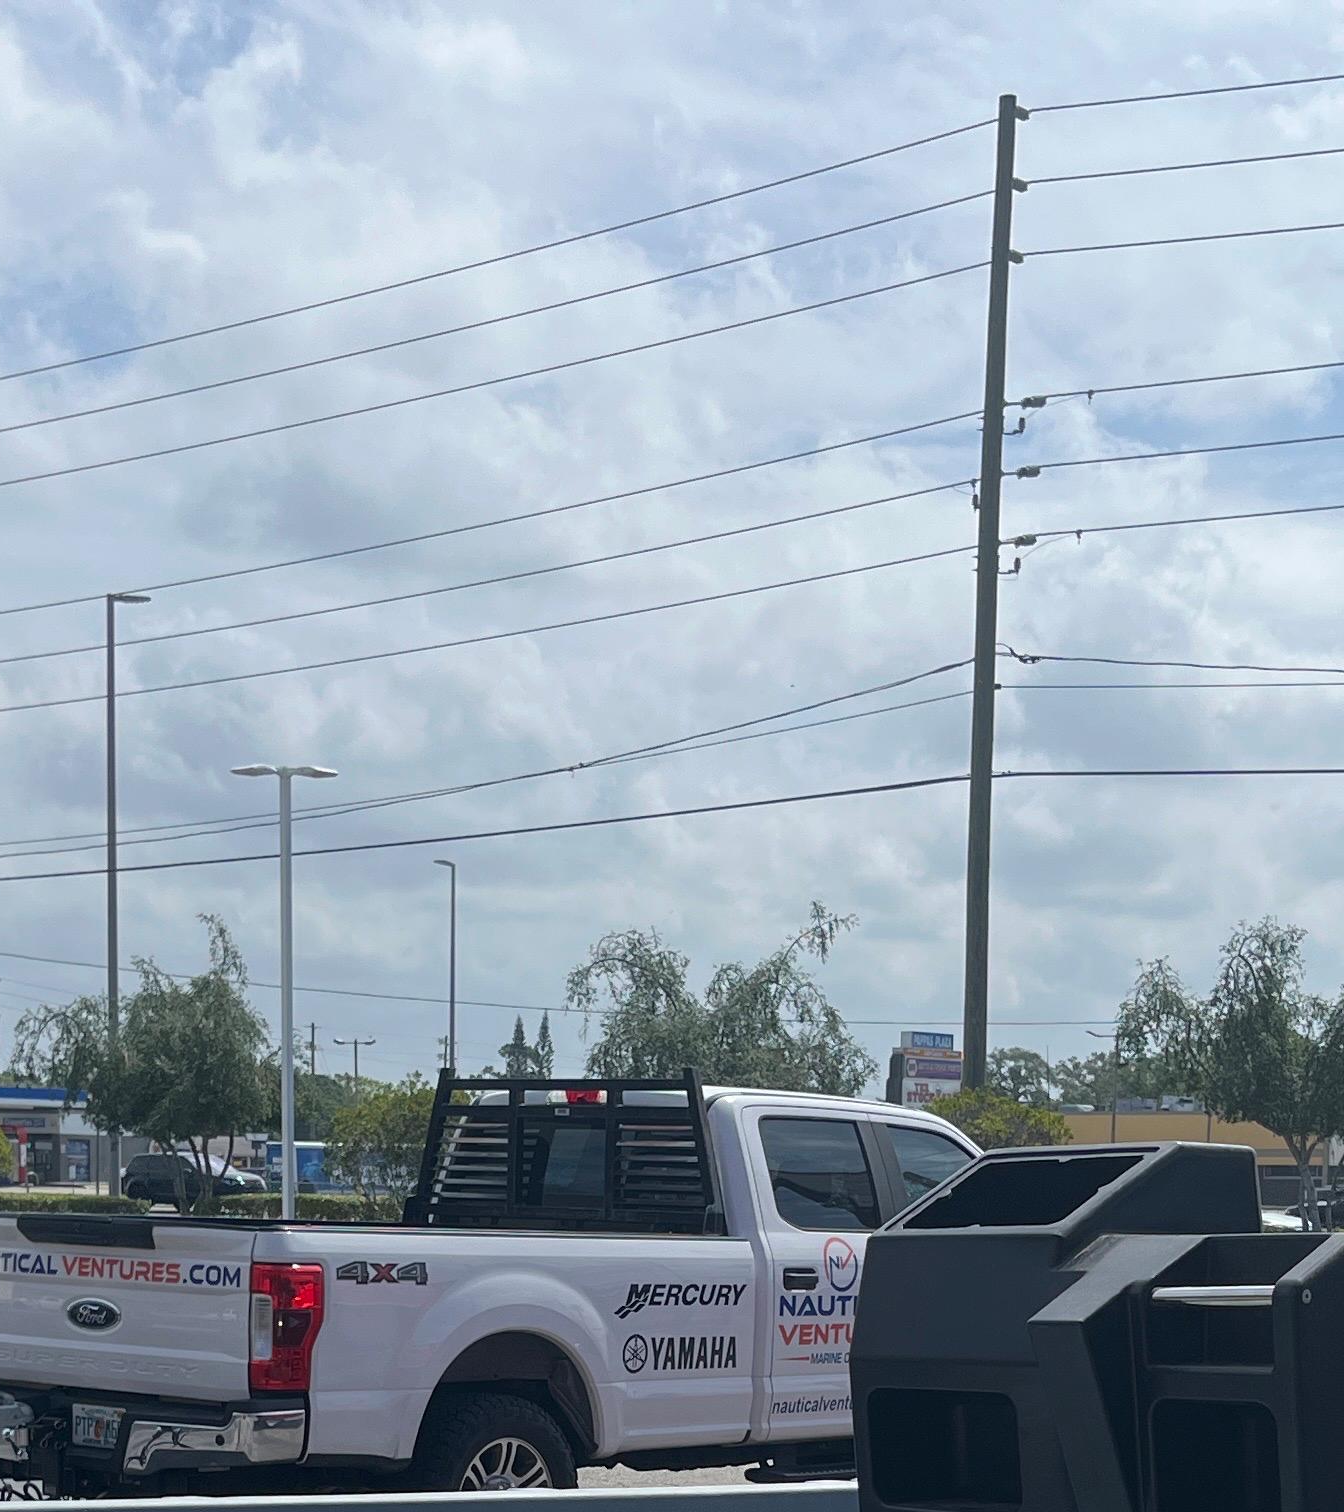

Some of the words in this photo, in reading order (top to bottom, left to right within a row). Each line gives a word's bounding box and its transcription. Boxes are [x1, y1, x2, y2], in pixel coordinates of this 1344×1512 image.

[62, 1254, 242, 1289] VENTURES.COM
[617, 1283, 748, 1314] MERCURY
[76, 1303, 108, 1325] Ford
[651, 1336, 737, 1371] YAMAHA
[810, 1352, 843, 1364] MARINE
[108, 1359, 200, 1379] DUTY
